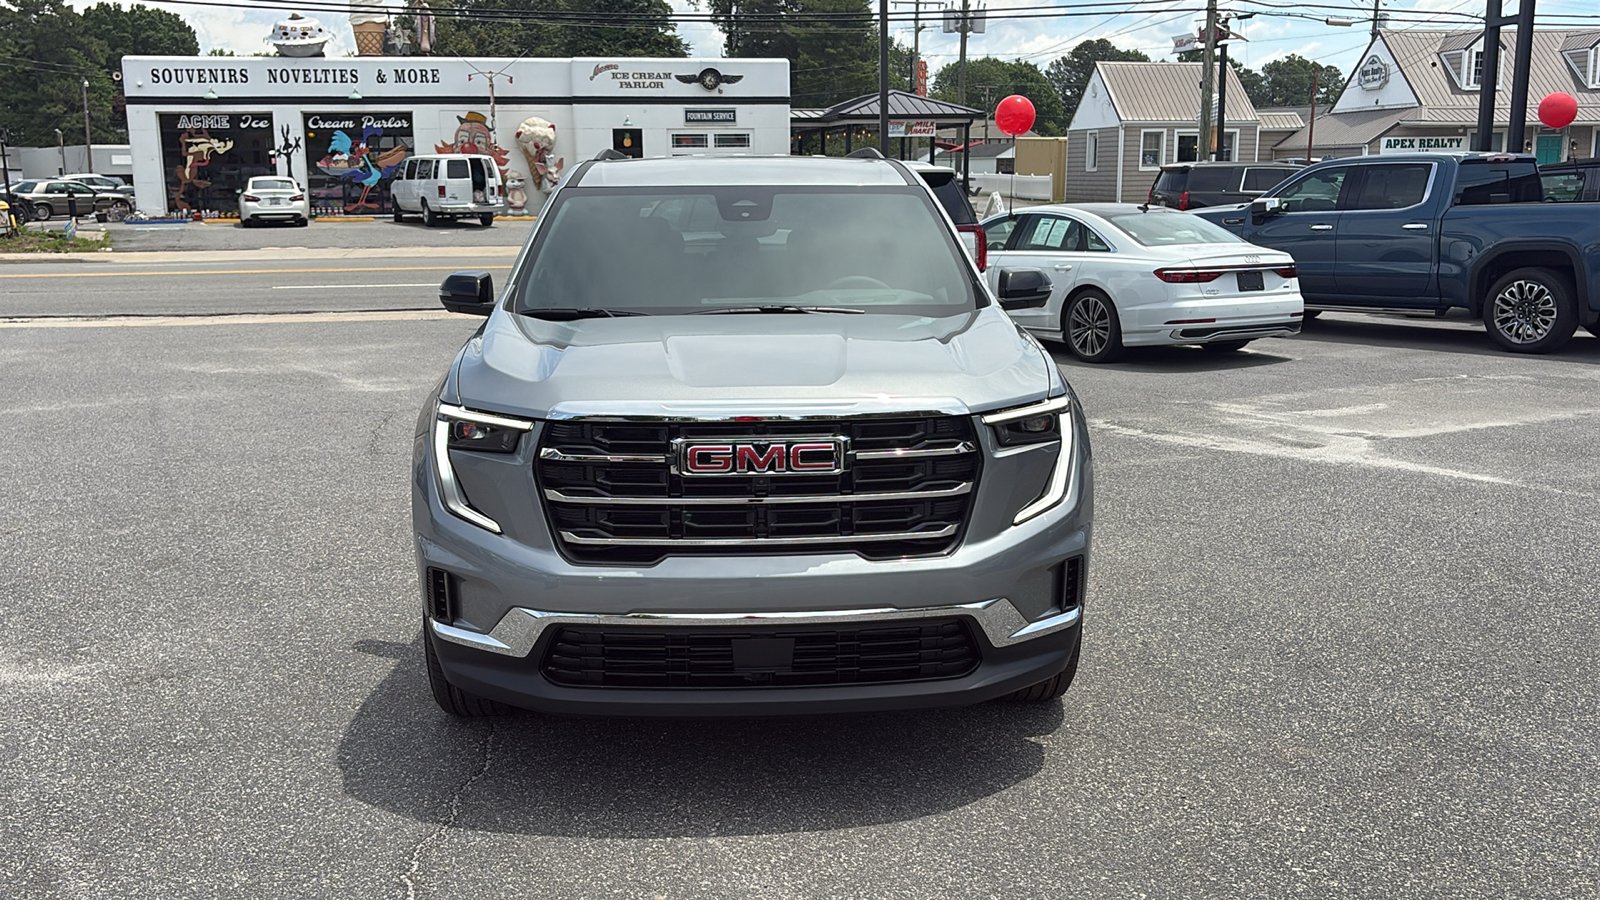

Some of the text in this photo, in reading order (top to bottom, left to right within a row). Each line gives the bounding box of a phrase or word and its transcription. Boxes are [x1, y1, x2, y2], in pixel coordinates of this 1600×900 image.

[151, 68, 440, 84] SOUVENIRS NOVELTIES & MORE
[611, 72, 672, 80] ICE CREAM
[619, 81, 664, 89] PARLOR
[177, 115, 271, 129] ACME Ice
[687, 112, 735, 120] FOUNTAIN SERVICE
[308, 116, 410, 129] Cream Parlor
[1385, 138, 1462, 149] APEX REALTY
[687, 443, 835, 473] GMC
